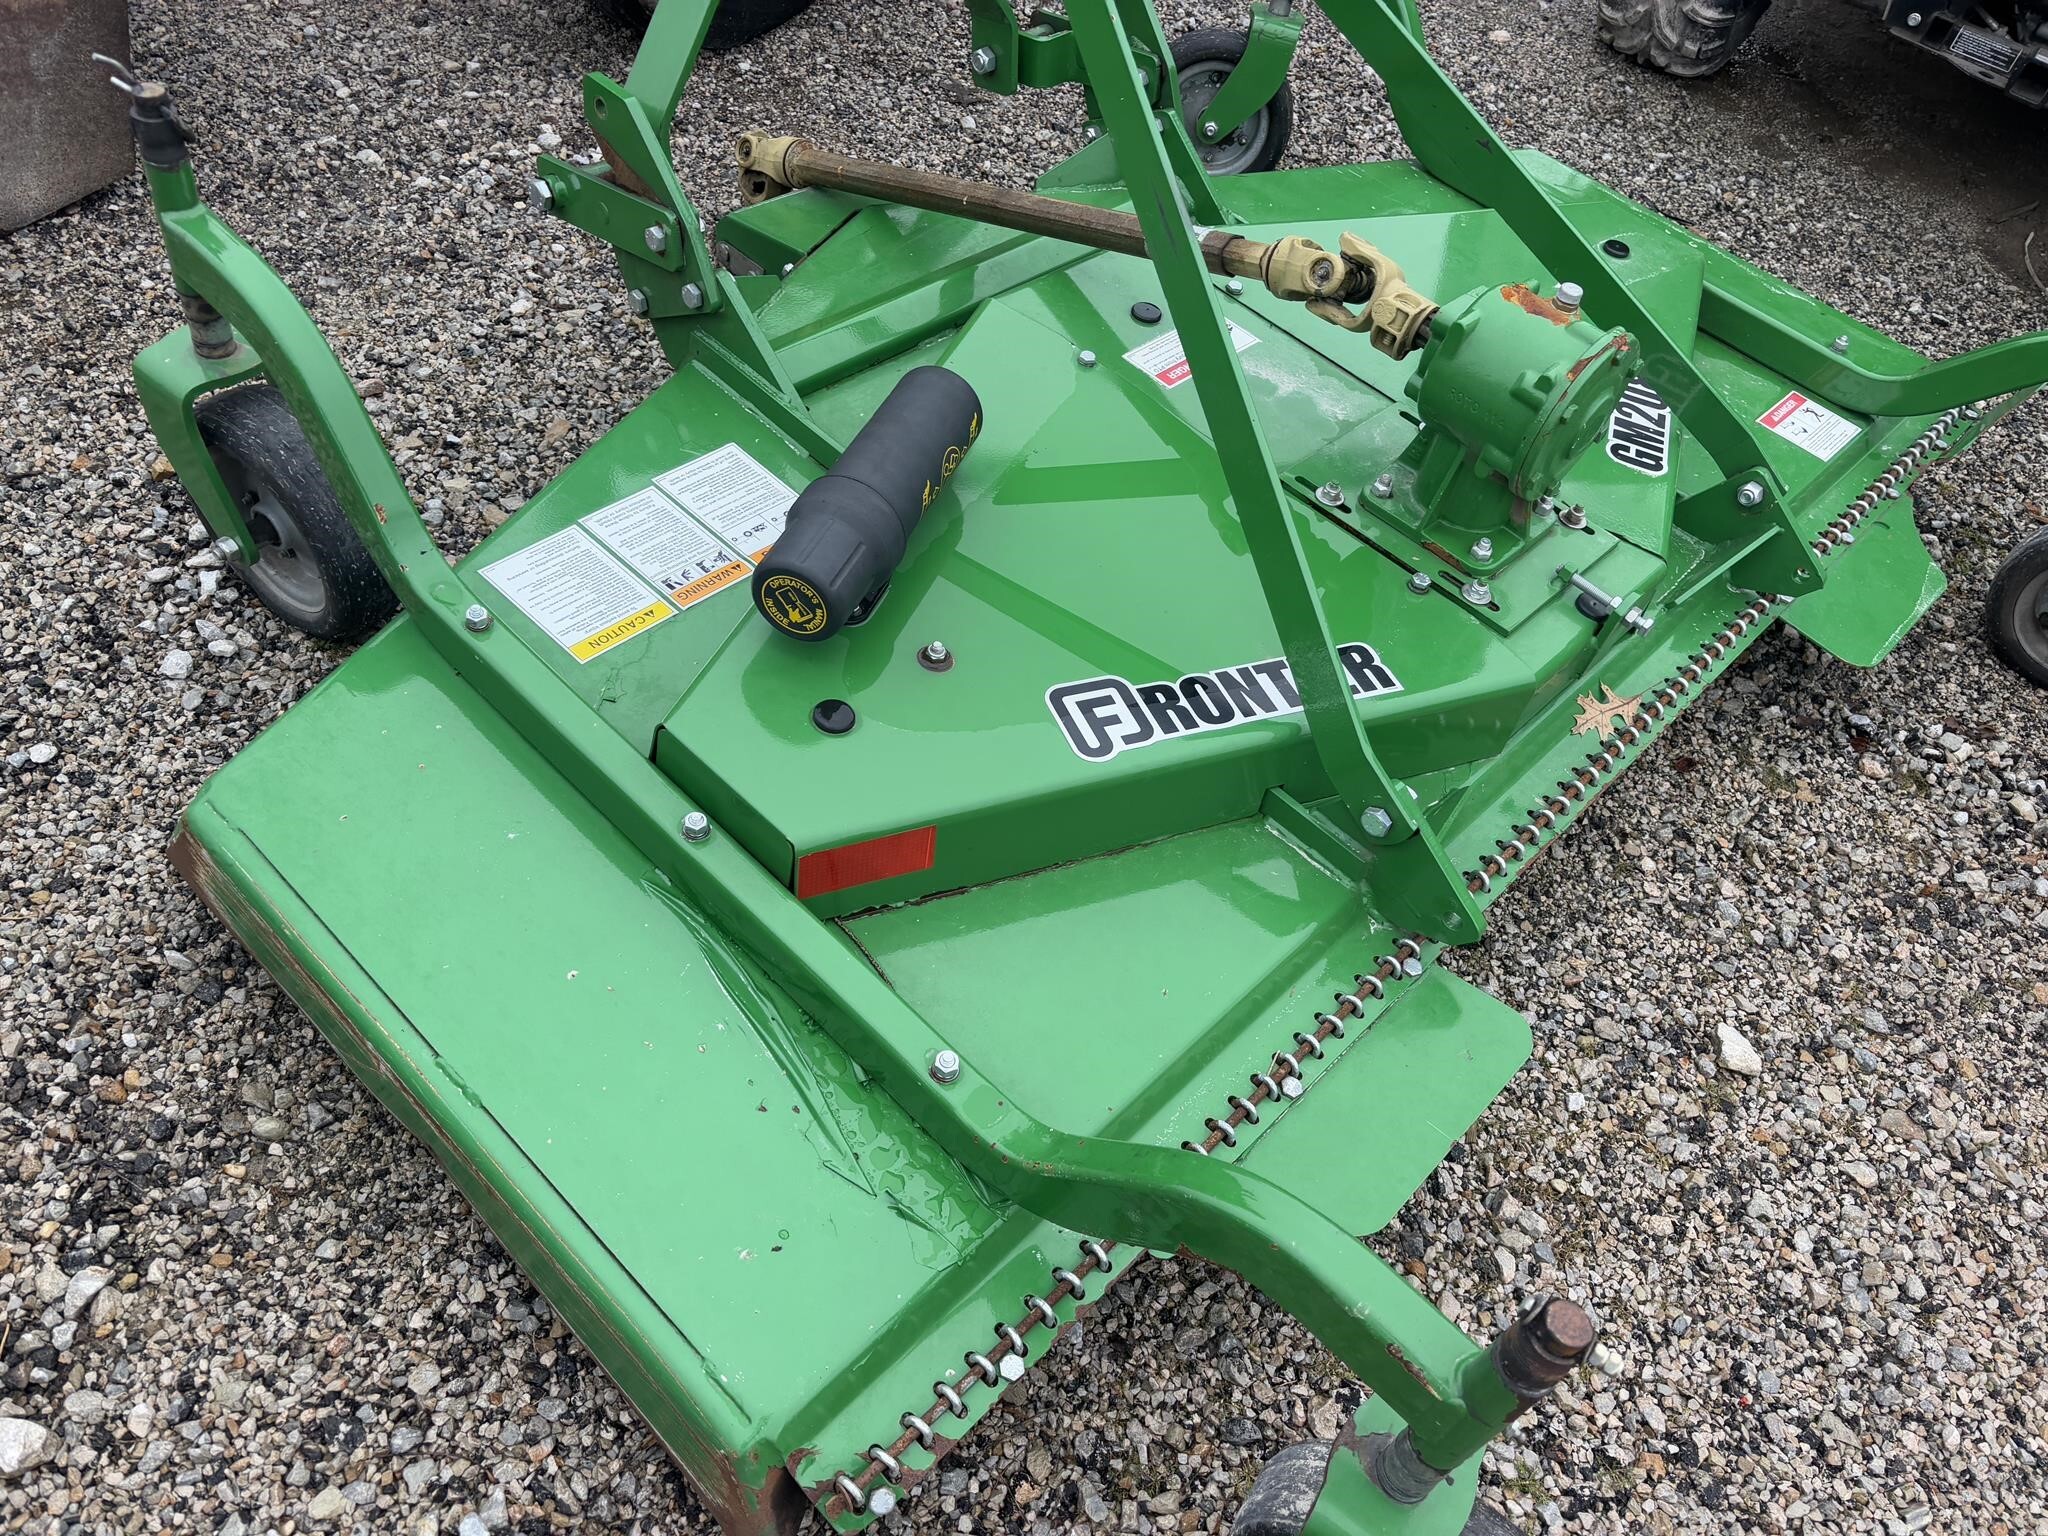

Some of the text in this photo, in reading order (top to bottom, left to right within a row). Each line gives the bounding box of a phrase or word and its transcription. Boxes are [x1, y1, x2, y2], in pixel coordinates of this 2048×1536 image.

[1772, 398, 1799, 418] DANGER
[1610, 377, 1667, 472] GM20
[676, 569, 731, 601] WARNING
[769, 578, 819, 605] OPERATOR'S
[765, 597, 790, 626] INSIDE
[803, 608, 824, 631] MANUAL
[588, 615, 646, 649] CAUTION
[1048, 644, 1397, 758] FRONTR
